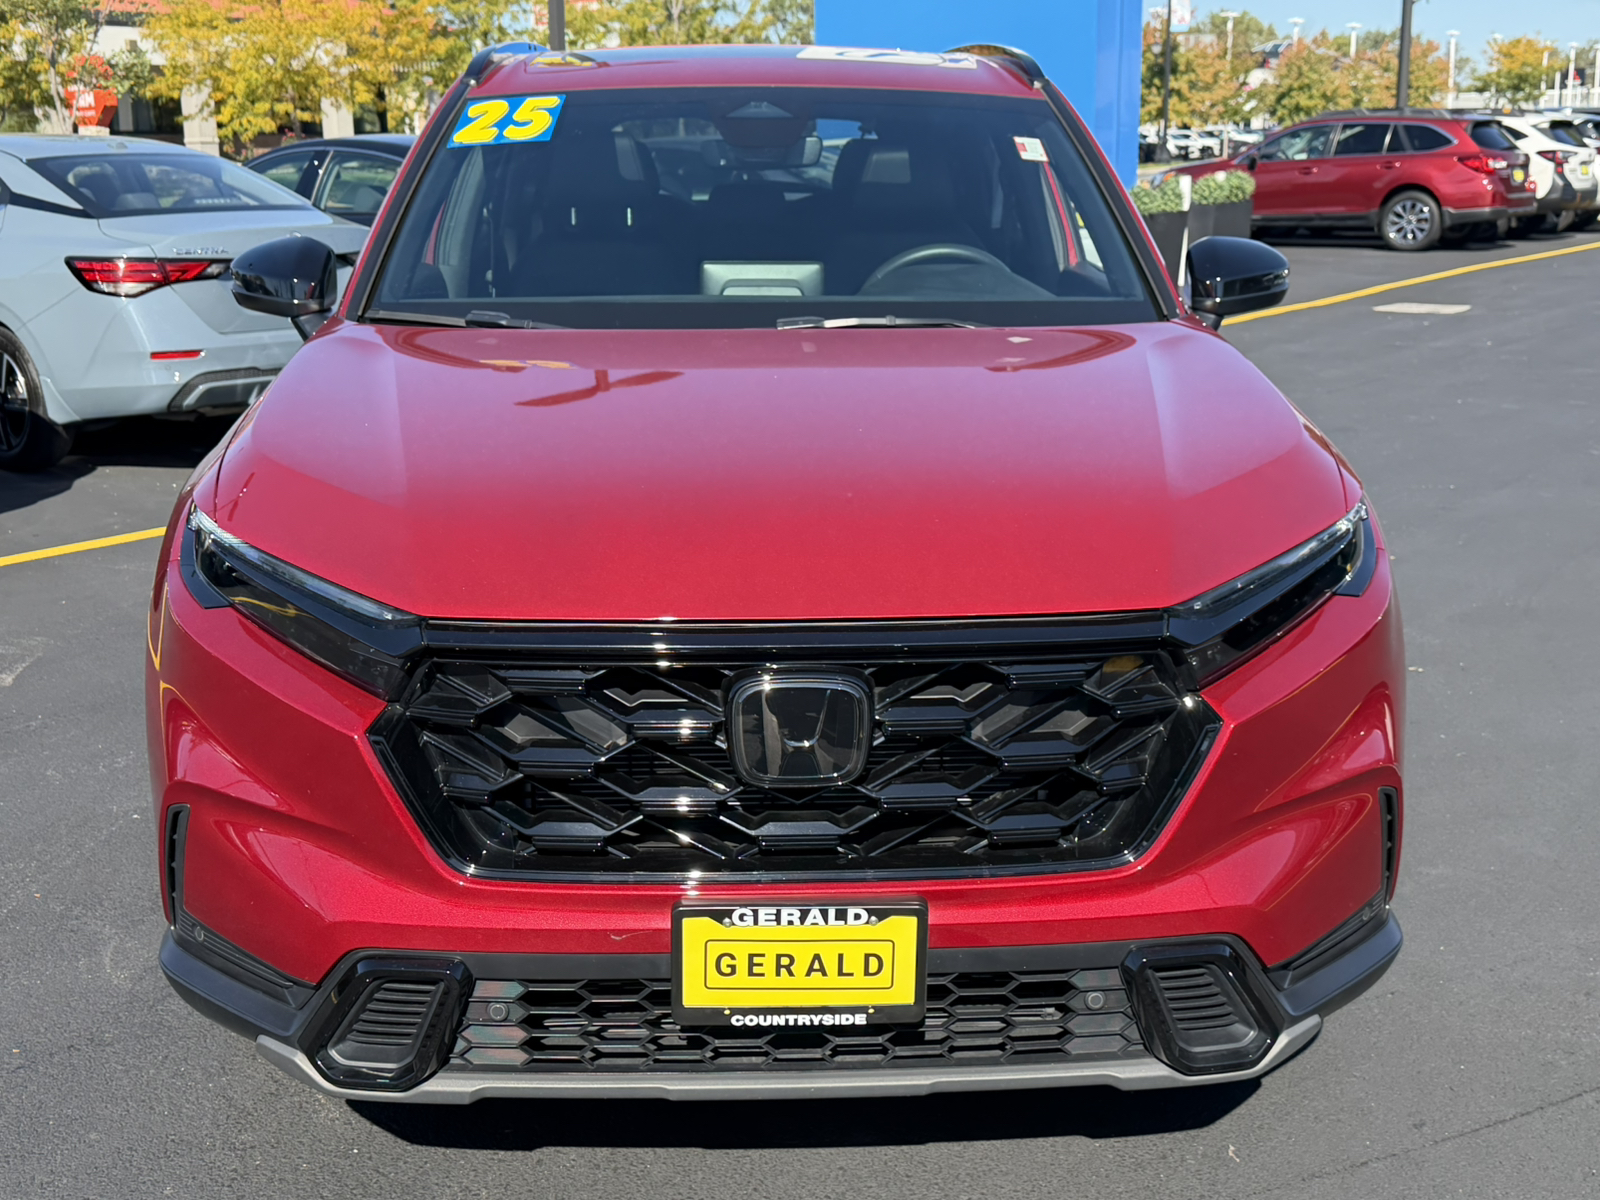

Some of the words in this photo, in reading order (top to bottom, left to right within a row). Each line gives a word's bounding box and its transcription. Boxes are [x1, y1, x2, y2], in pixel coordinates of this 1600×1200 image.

[453, 96, 560, 144] 25
[731, 907, 869, 927] GERALD
[714, 953, 884, 978] GERALD
[730, 1014, 868, 1026] COUNTRYSIDE
